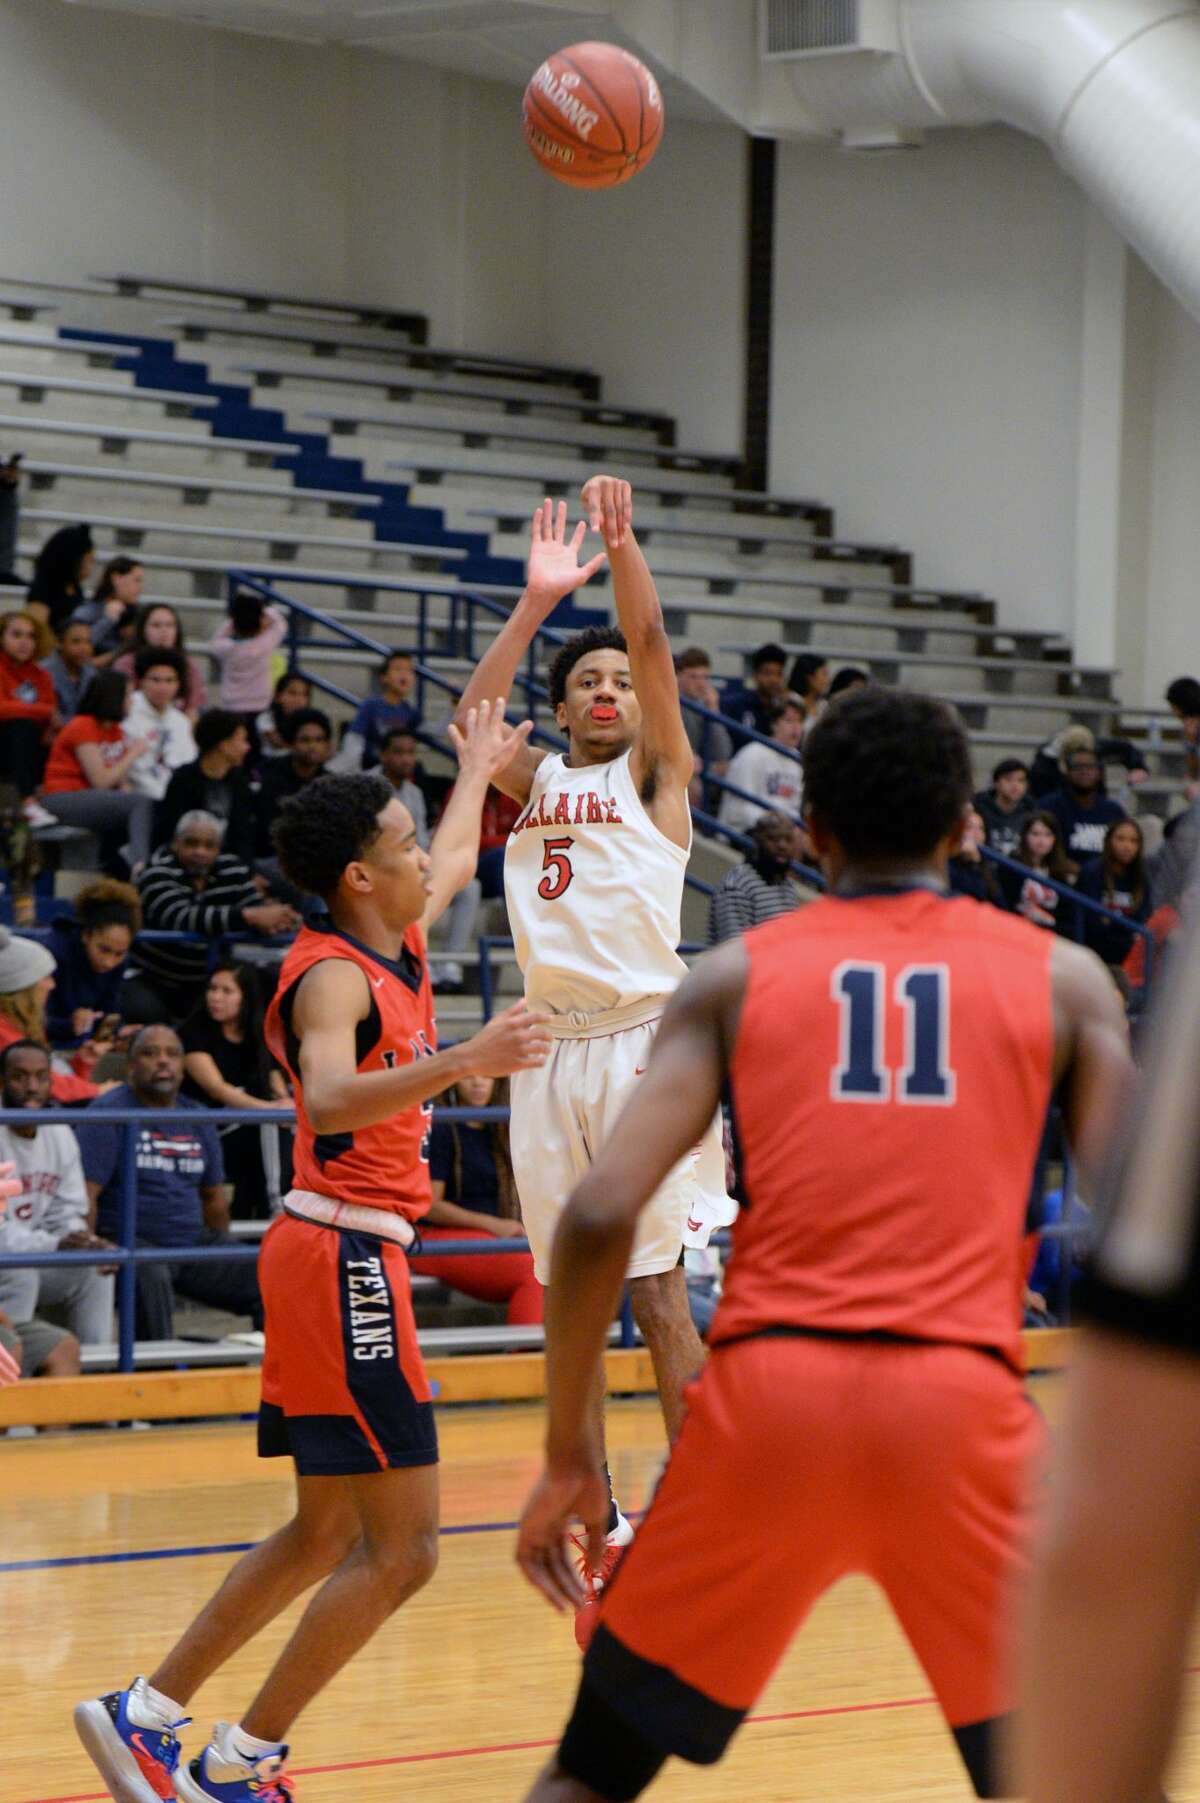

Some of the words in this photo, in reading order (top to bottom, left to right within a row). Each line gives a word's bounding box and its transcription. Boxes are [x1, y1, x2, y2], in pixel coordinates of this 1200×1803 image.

[537, 836, 575, 900] 5
[830, 959, 957, 1107] 11
[346, 1256, 394, 1361] TEXANS
